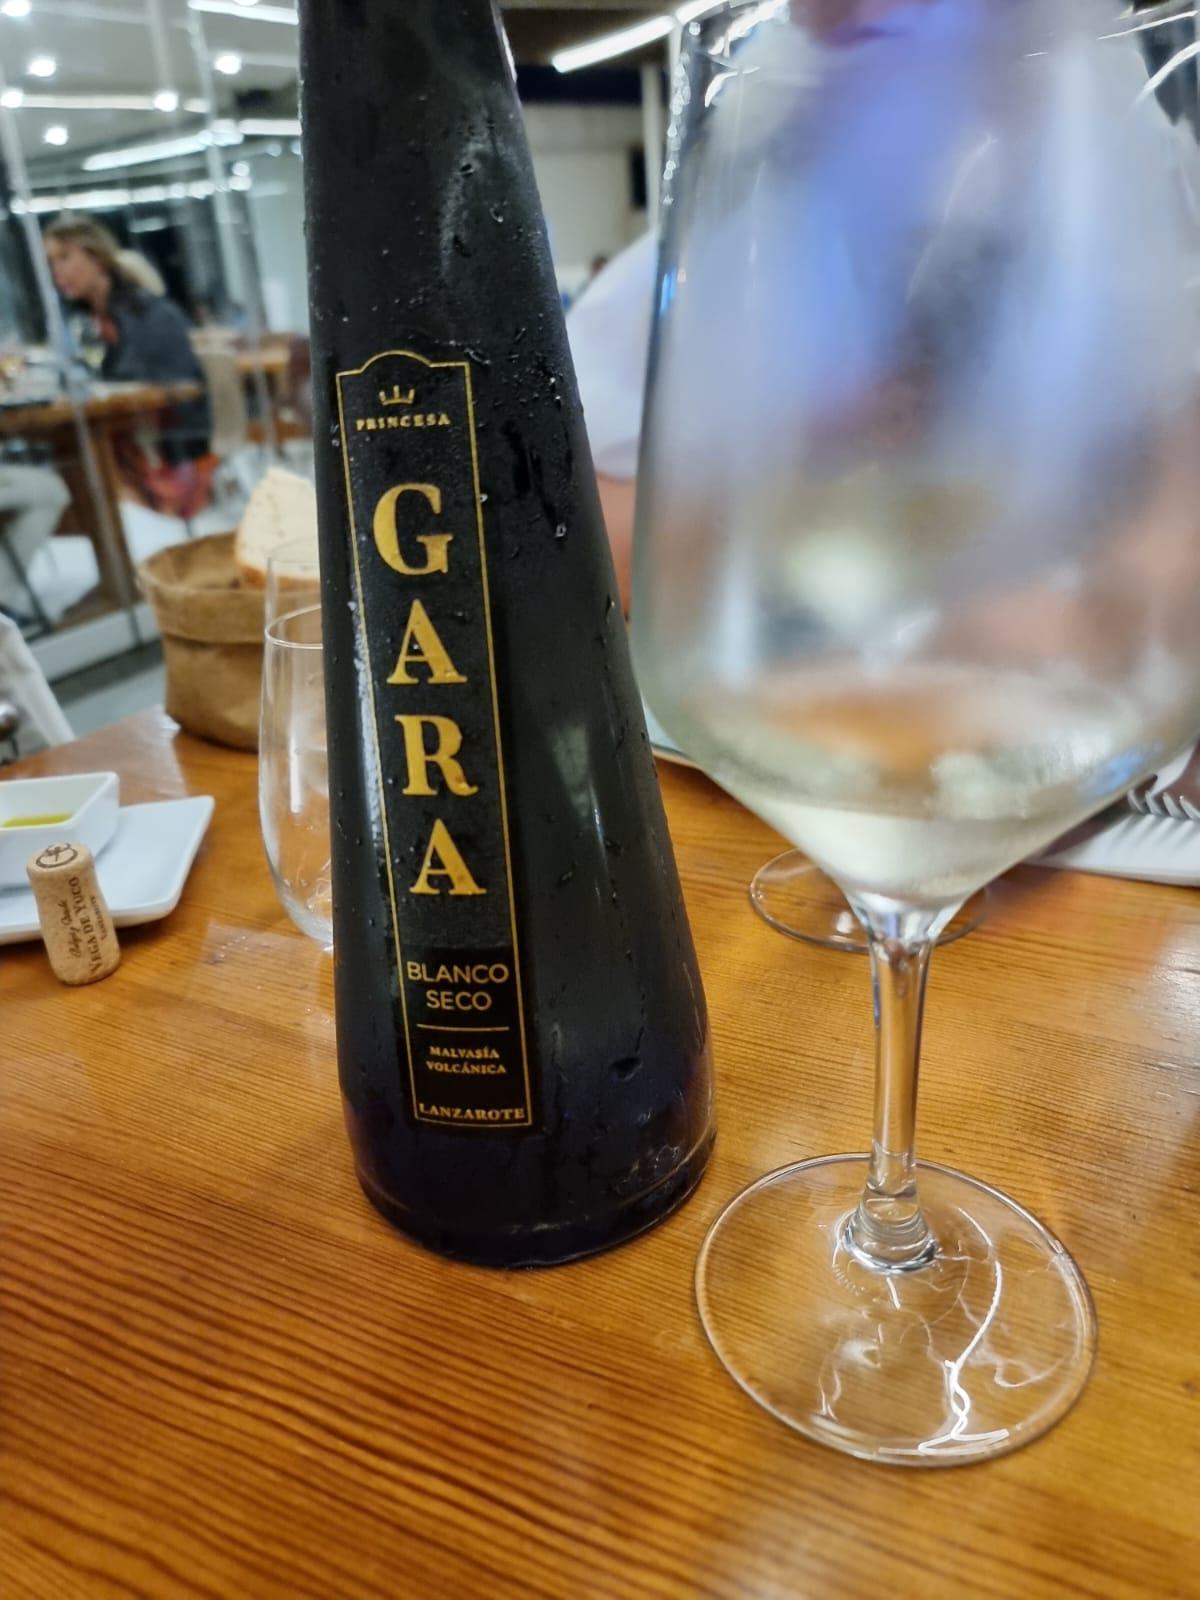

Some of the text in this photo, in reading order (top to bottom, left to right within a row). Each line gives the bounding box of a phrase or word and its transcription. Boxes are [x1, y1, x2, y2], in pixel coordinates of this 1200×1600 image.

[356, 413, 450, 431] PRINCESA
[372, 482, 487, 895] GARA
[406, 960, 510, 983] BLANCO
[426, 989, 493, 1011] SECO
[429, 1046, 500, 1059] MALVASÍA
[426, 1061, 507, 1074] VOLCÁNICA
[418, 1103, 526, 1120] LANZAROTE
